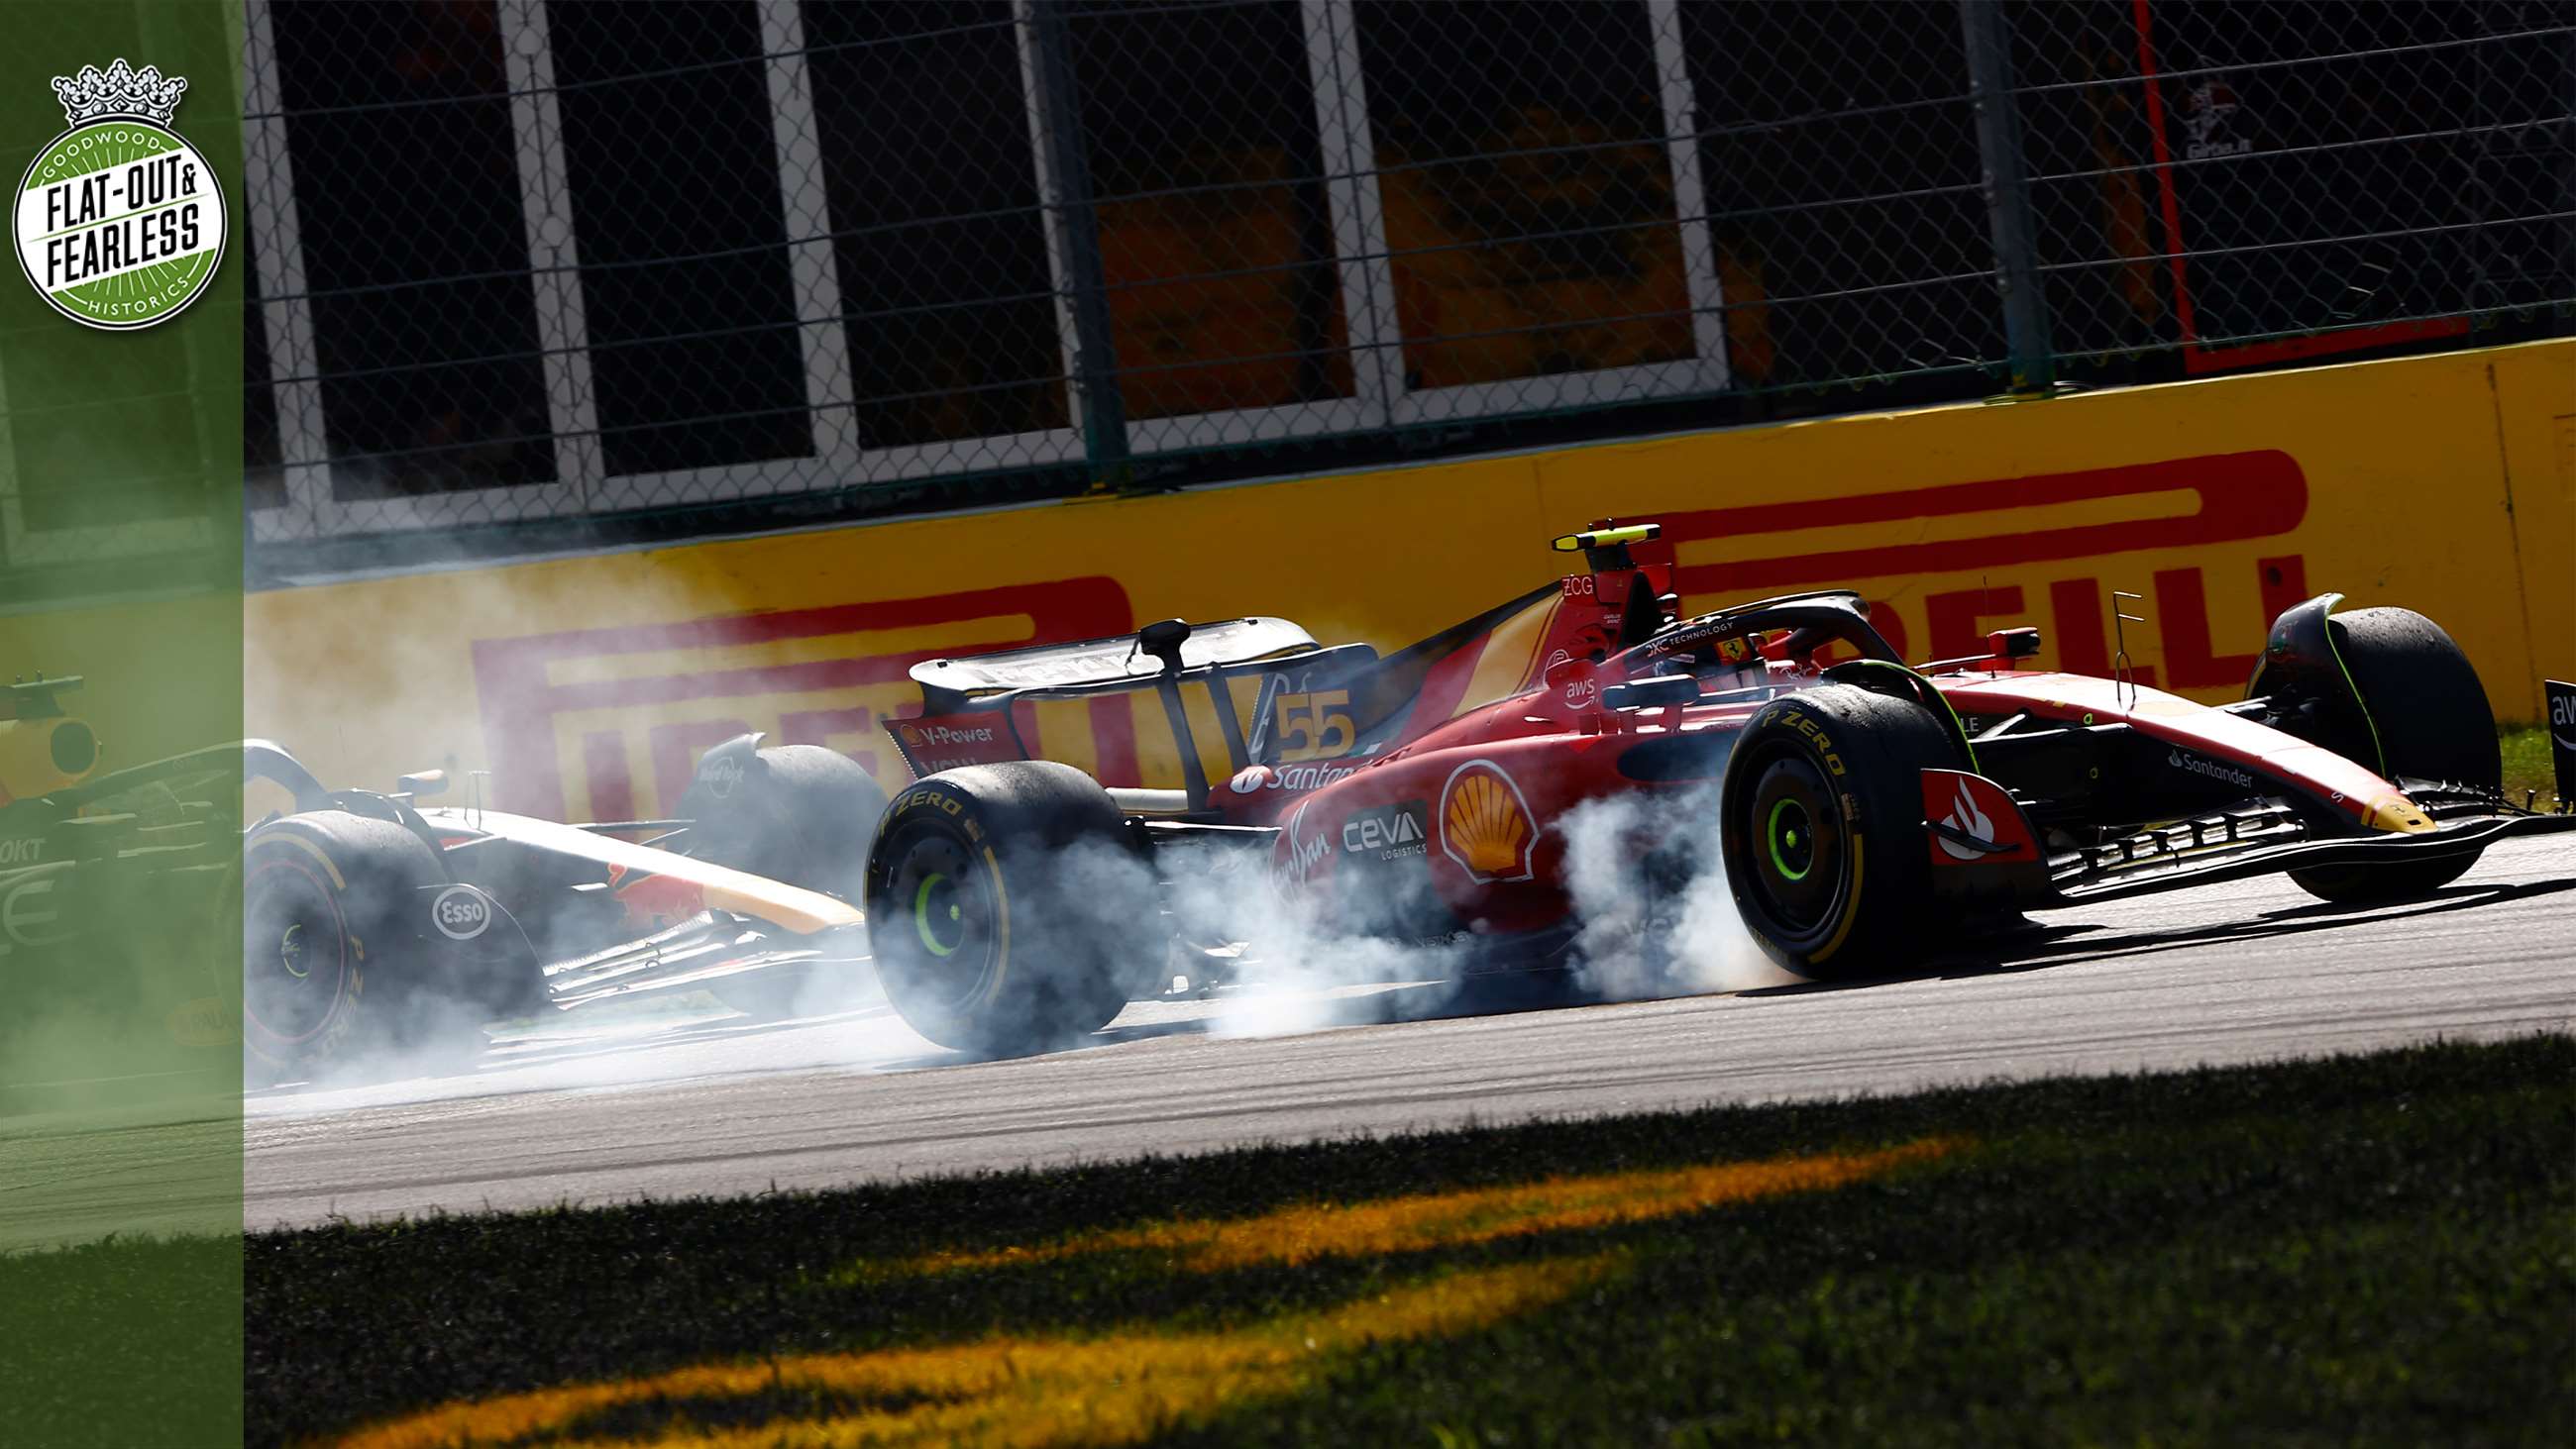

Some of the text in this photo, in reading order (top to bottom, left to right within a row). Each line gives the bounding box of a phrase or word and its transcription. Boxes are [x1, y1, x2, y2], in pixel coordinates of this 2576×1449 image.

[1562, 576, 1594, 595] ZCG
[1669, 621, 1734, 646] TECHNOLOGY
[1566, 678, 1595, 698] aws
[2552, 695, 2576, 726] aw
[920, 726, 994, 746] V-Power
[1276, 689, 1355, 762] 55
[1780, 709, 1846, 776] ZERO
[2183, 753, 2253, 789] Santander
[895, 791, 964, 817] ZERO
[0, 837, 47, 864] OKT
[1380, 843, 1428, 861] LOGISTICS
